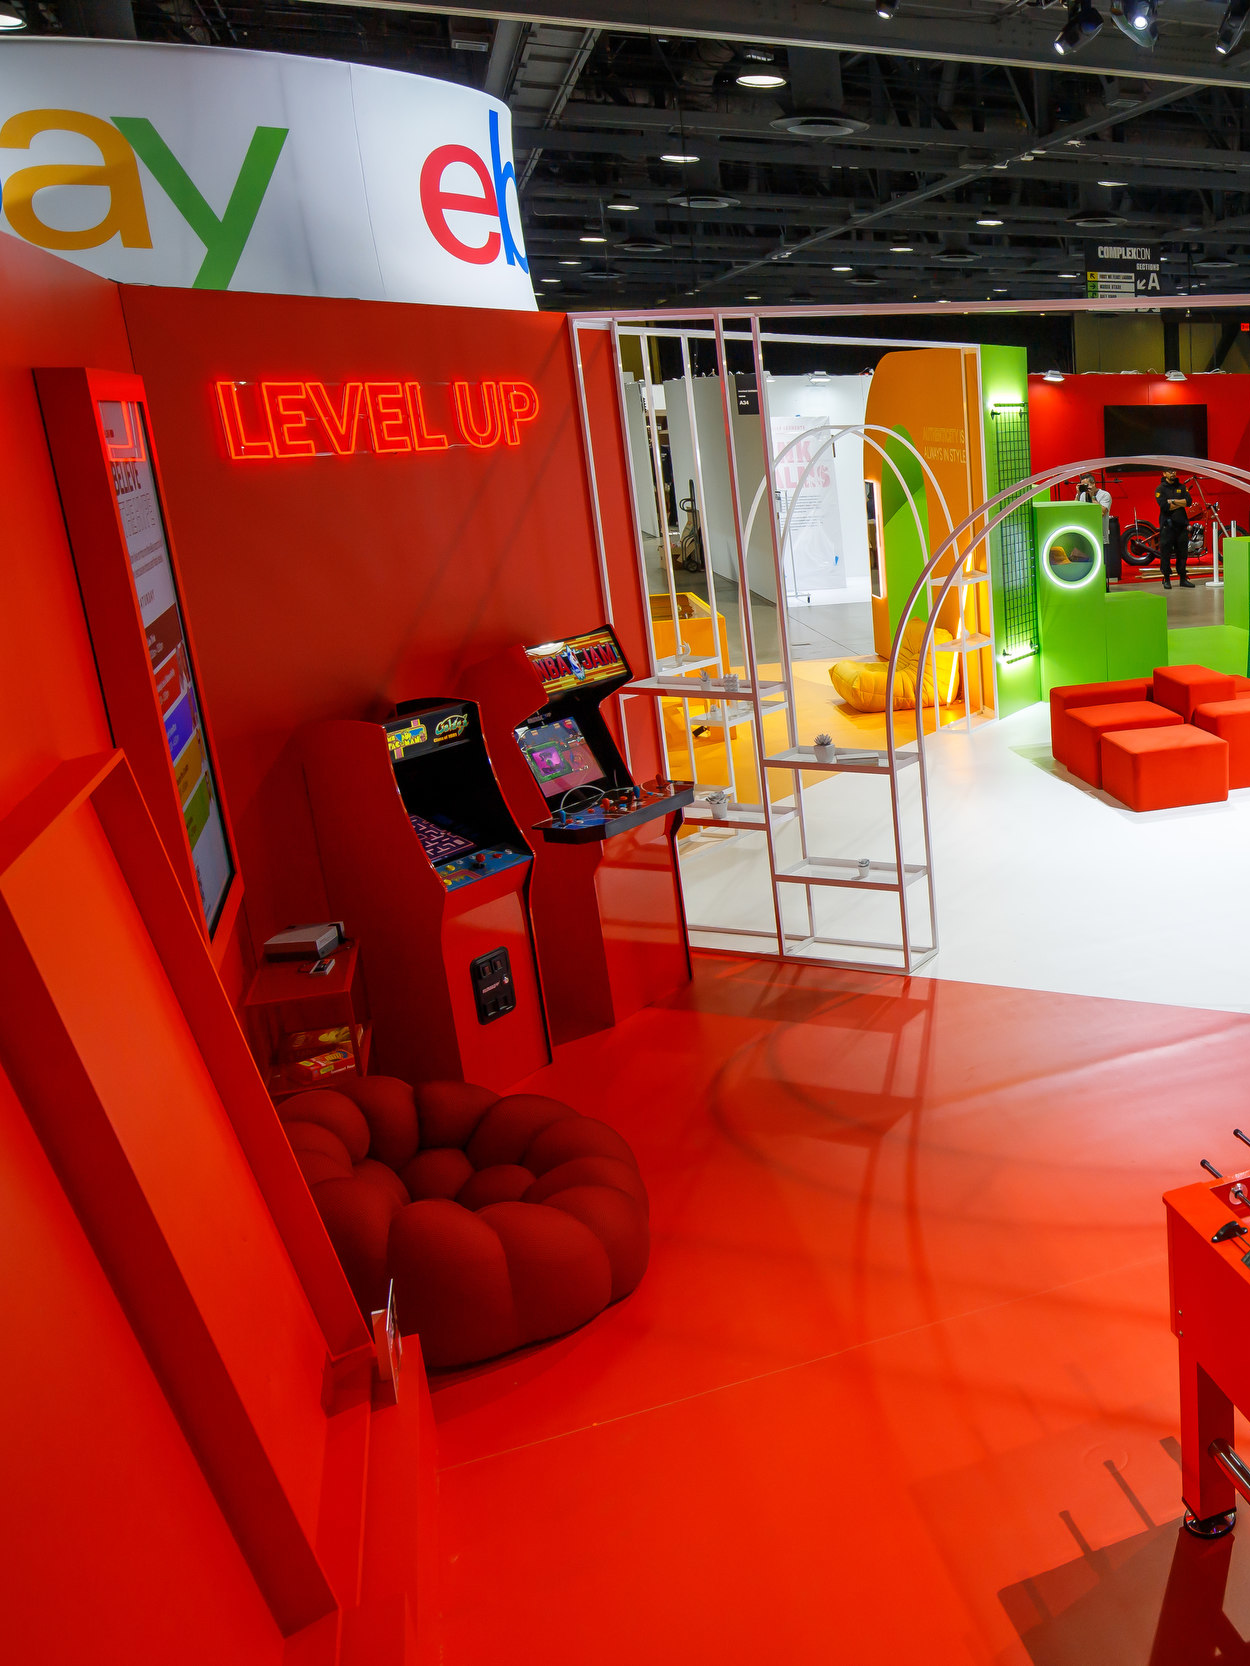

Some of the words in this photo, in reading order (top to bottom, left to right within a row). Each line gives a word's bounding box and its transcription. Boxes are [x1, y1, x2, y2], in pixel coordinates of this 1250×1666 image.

[0, 108, 289, 290] ay
[1097, 246, 1151, 260] COMPLEXCON
[1136, 263, 1160, 271] SECTIONS
[1147, 272, 1160, 290] A
[215, 381, 448, 460] LEVEL
[453, 381, 539, 449] UP
[532, 654, 573, 682] NBA
[582, 642, 618, 671] JAM
